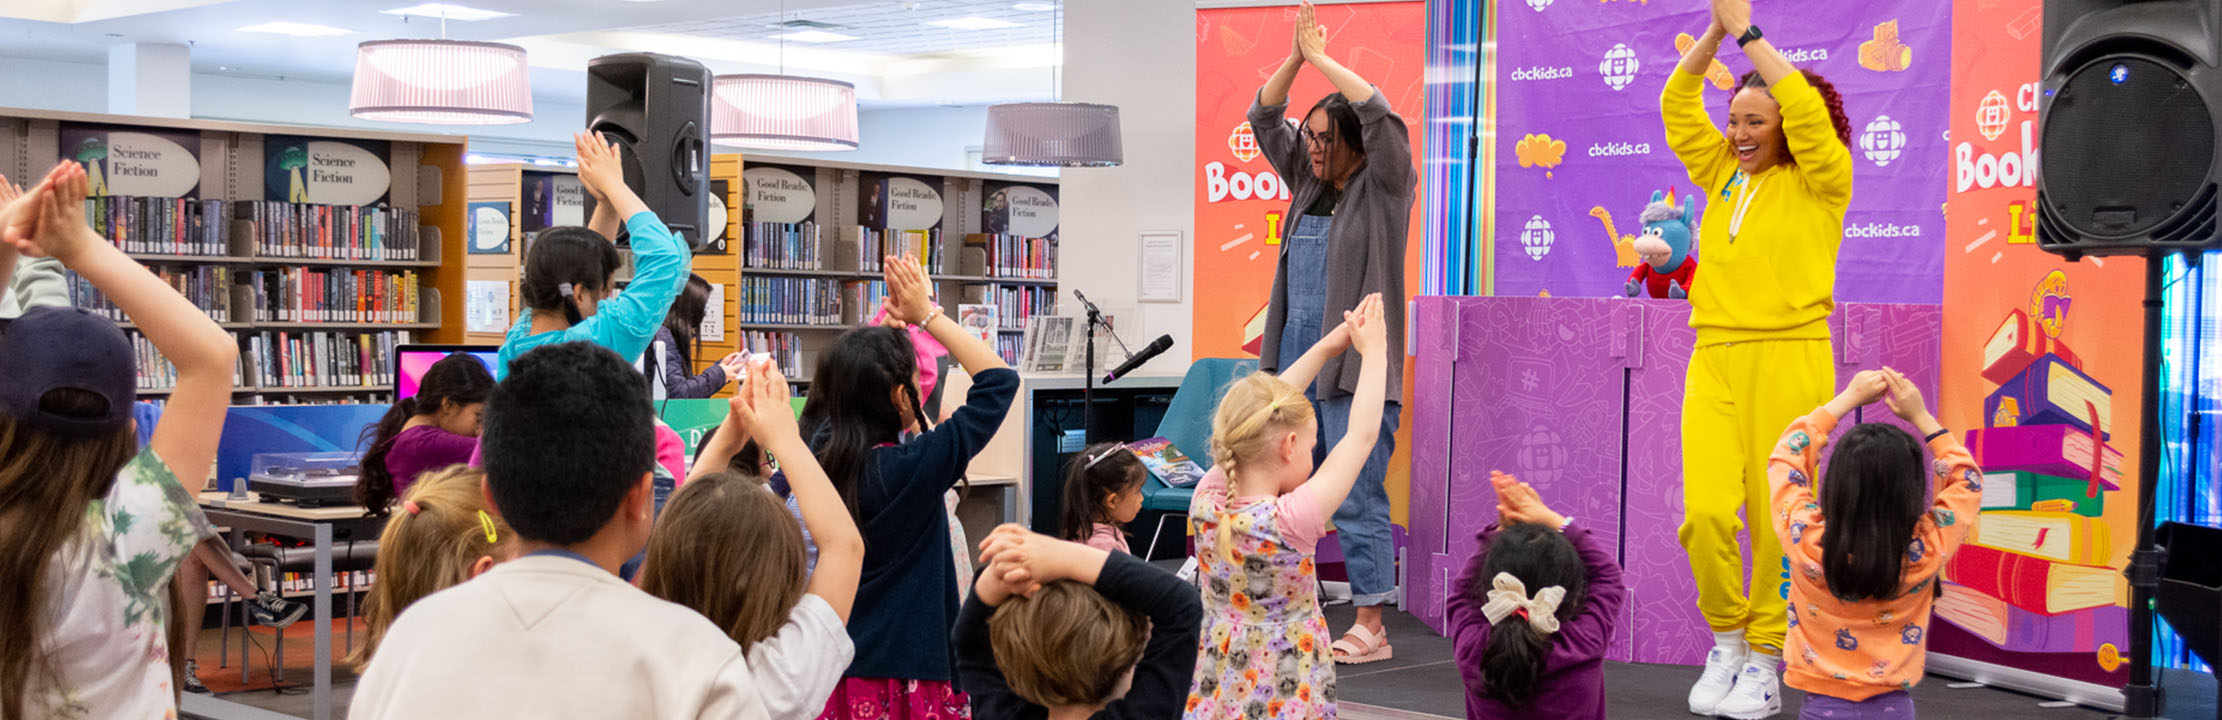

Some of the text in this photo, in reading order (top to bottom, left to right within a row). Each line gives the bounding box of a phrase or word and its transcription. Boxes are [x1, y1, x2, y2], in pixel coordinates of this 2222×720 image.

[1779, 48, 1828, 63] kids.ca
[1511, 66, 1573, 81] cbckids.ca
[113, 144, 162, 160] Science
[1588, 142, 1650, 157] cbckids.ca
[312, 153, 356, 168] Science
[113, 161, 158, 177] Fiction
[313, 169, 353, 184] Fiction
[757, 177, 779, 189] Good
[757, 190, 787, 203] Fiction
[891, 187, 912, 199] Good
[1012, 195, 1031, 206] Good
[891, 199, 918, 211] Fiction
[1013, 207, 1037, 218] Fiction
[1844, 222, 1920, 238] cbckids.ca
